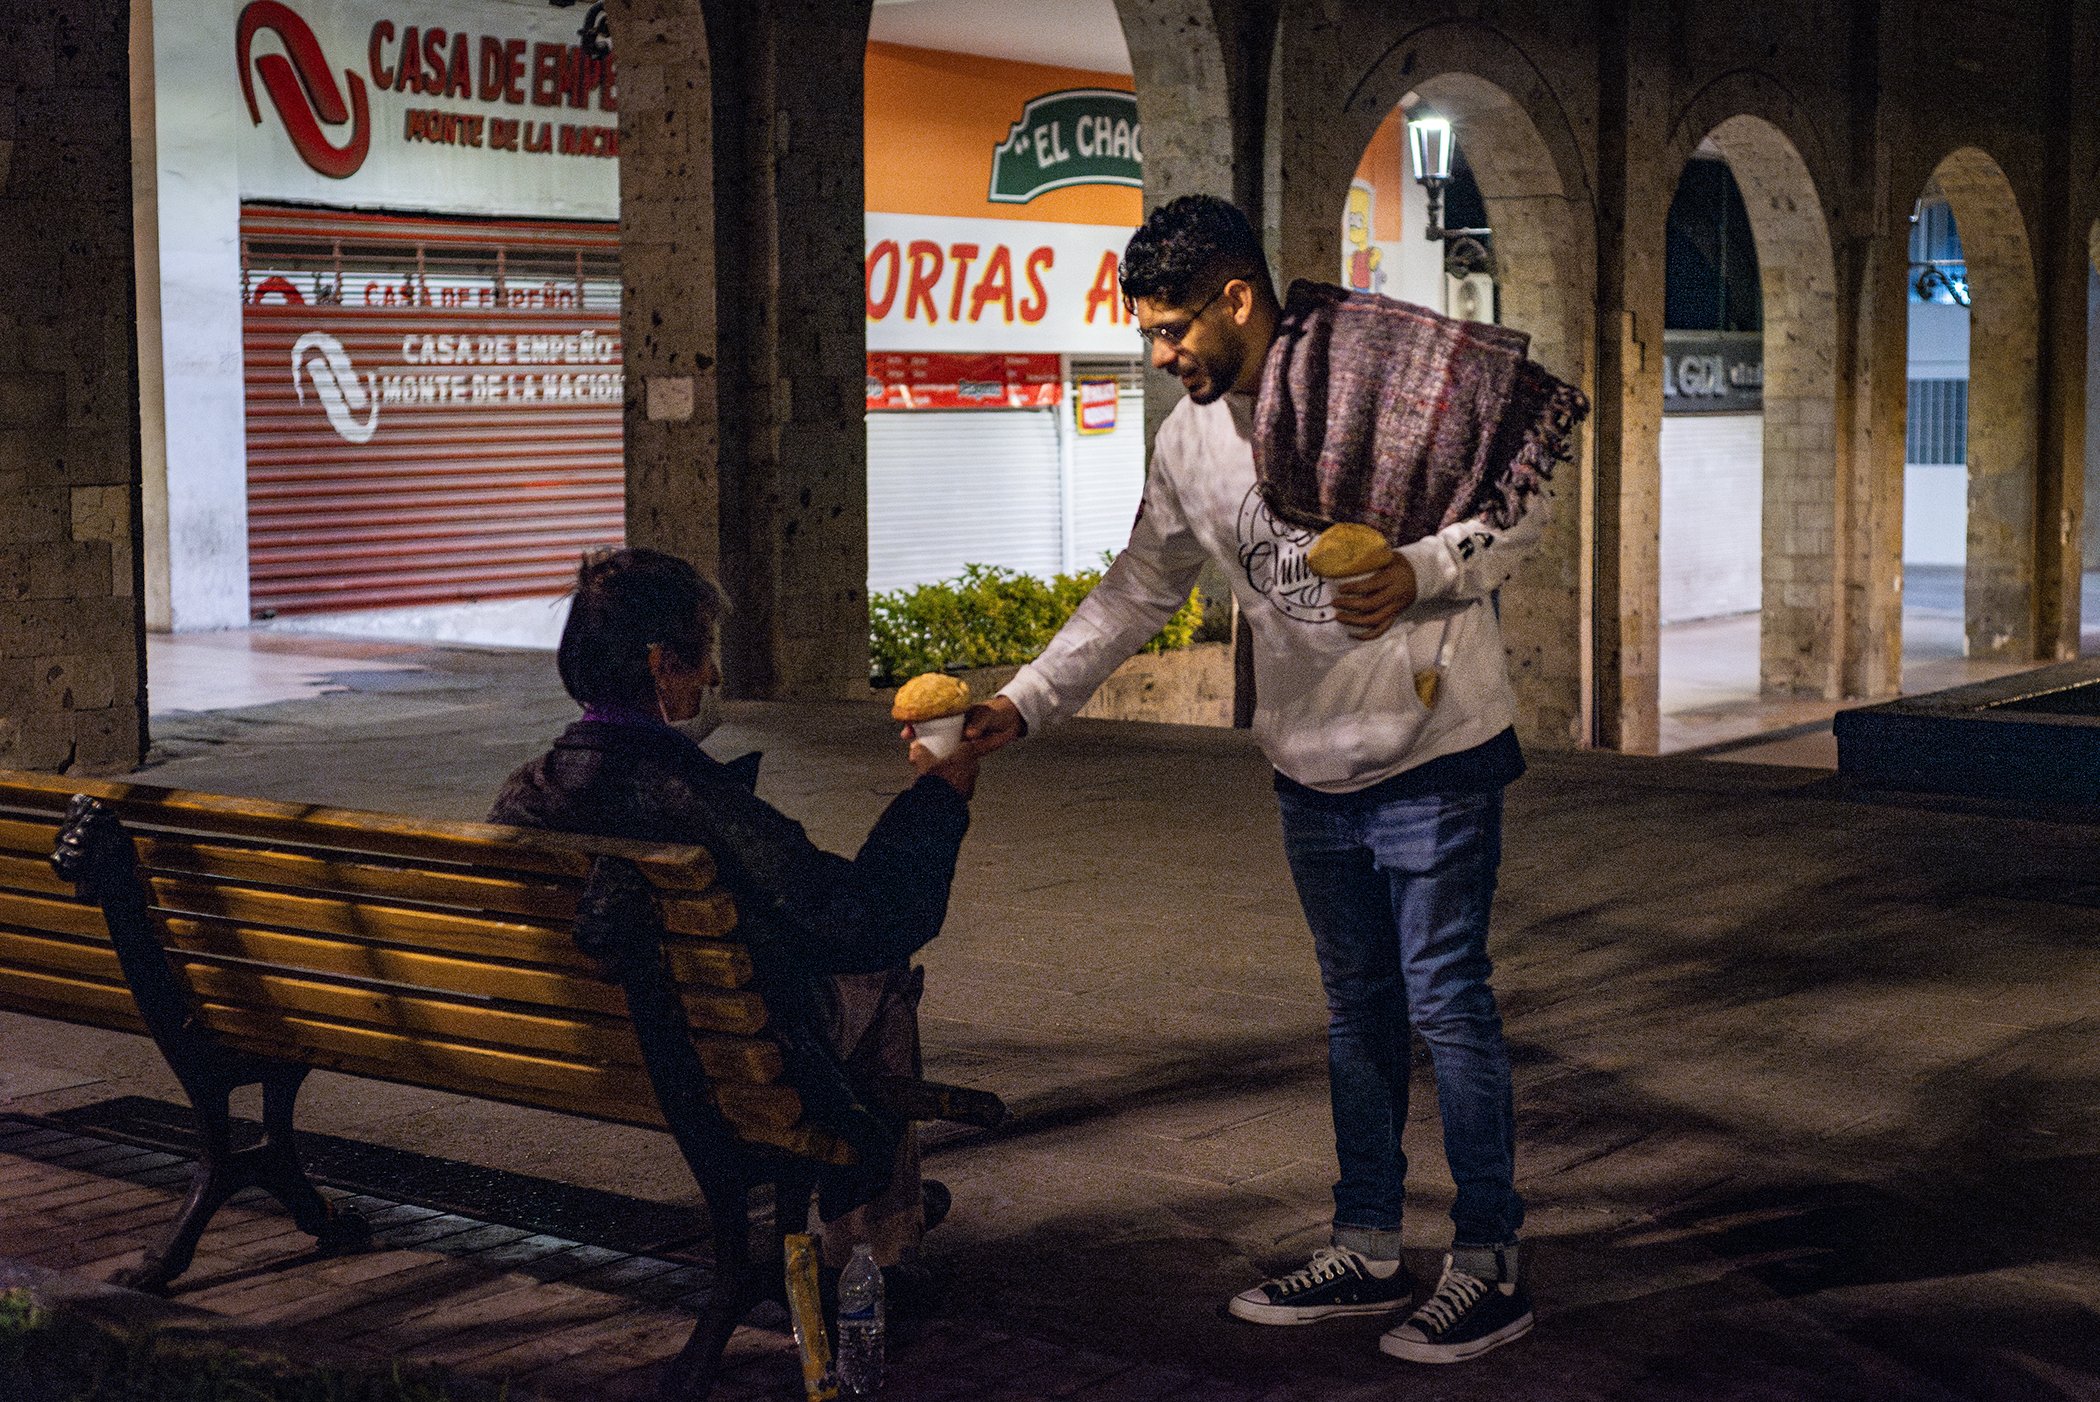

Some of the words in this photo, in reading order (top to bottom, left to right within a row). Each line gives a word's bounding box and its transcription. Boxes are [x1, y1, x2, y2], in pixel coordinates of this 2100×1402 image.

[368, 19, 471, 99] CASA
[479, 34, 527, 105] DE
[404, 107, 484, 148] MONTE
[488, 116, 521, 152] DE
[523, 121, 553, 154] LA
[1084, 248, 1132, 326] A
[402, 334, 474, 364] CASA
[477, 335, 514, 364] DE
[516, 329, 613, 364] EMPEÑO
[382, 373, 472, 402] MONTE
[472, 373, 503, 402] DE
[507, 373, 540, 402] LA
